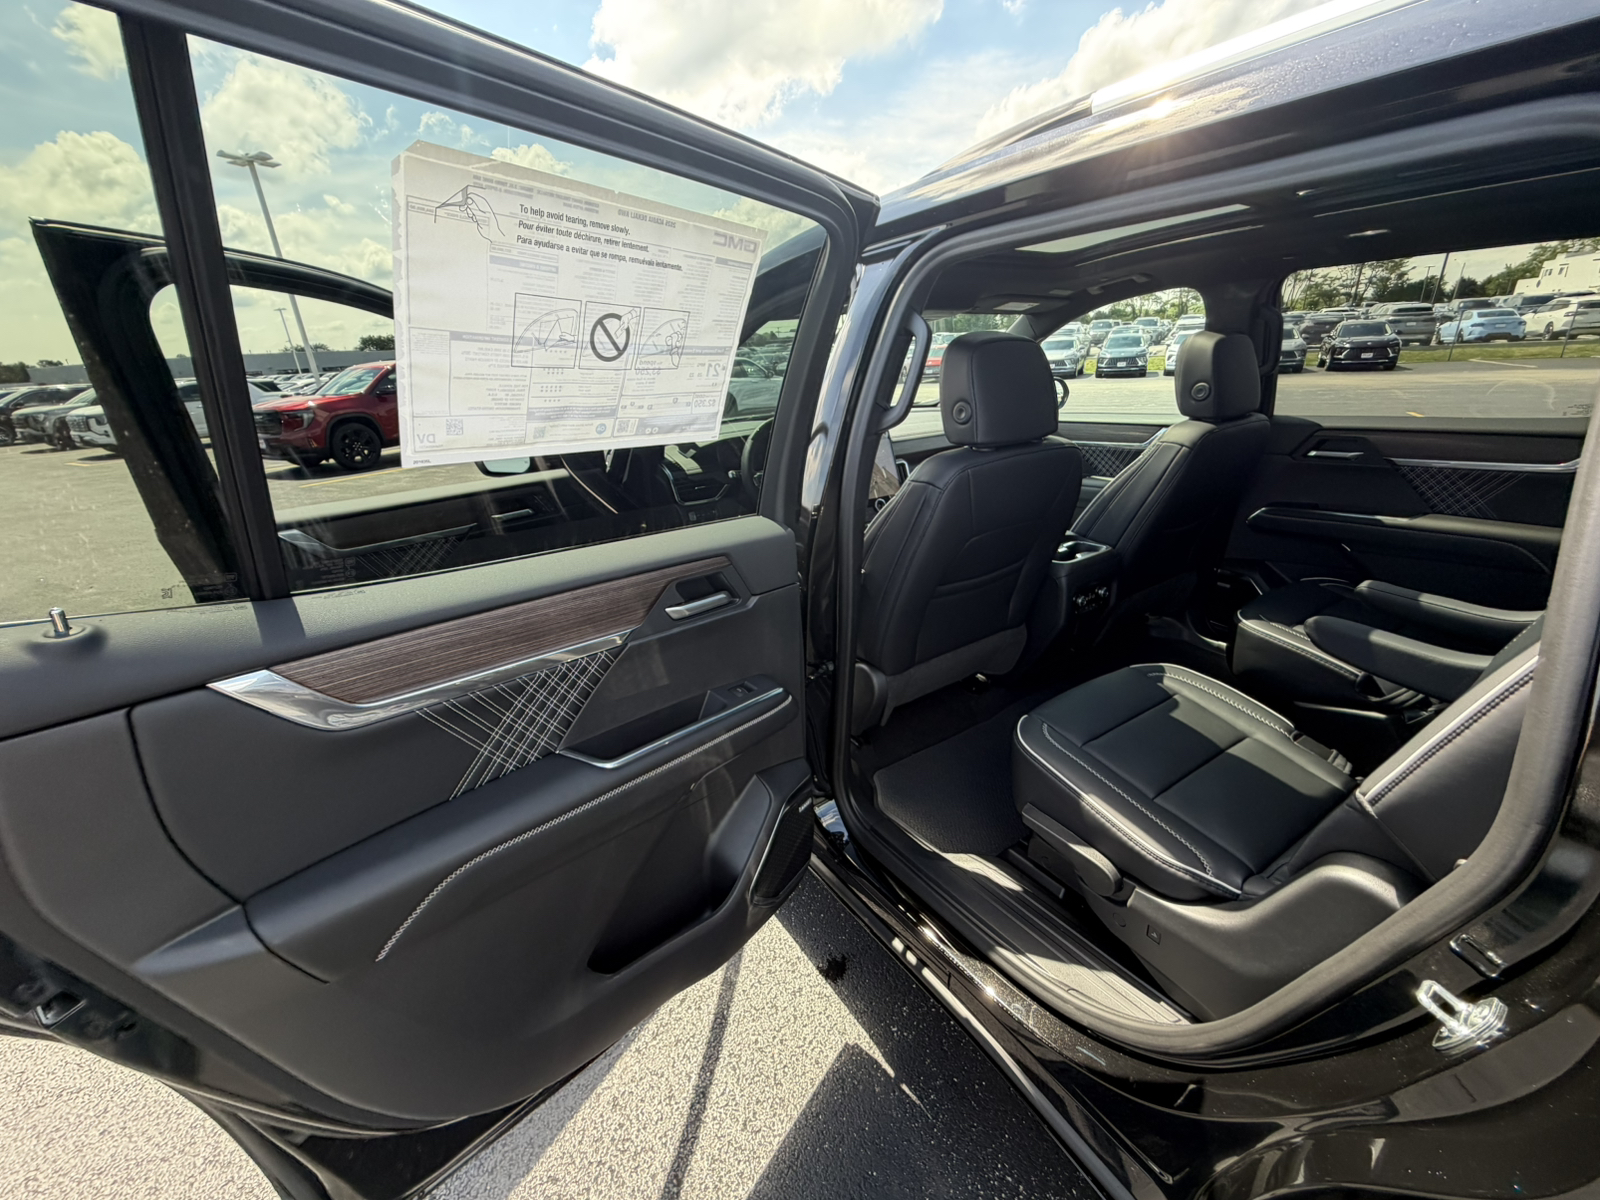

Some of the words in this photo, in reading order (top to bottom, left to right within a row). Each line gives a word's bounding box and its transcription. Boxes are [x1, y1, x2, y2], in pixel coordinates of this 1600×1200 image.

[518, 219, 534, 231] Pour
[535, 222, 554, 234] éviter
[556, 228, 572, 238] toute
[574, 230, 602, 245] déchirure,
[603, 237, 621, 247] retirer
[519, 203, 528, 214] To
[530, 206, 545, 218] help
[546, 210, 564, 222] avoid
[565, 214, 588, 228] tearing,
[589, 220, 610, 231] remove
[611, 223, 630, 236] slowly.
[516, 234, 532, 246] Para
[533, 239, 564, 251] ayudarse
[565, 245, 570, 253] a
[571, 244, 588, 256] evitar
[589, 249, 600, 259] que
[601, 252, 608, 260] se
[608, 252, 627, 264] rompa,
